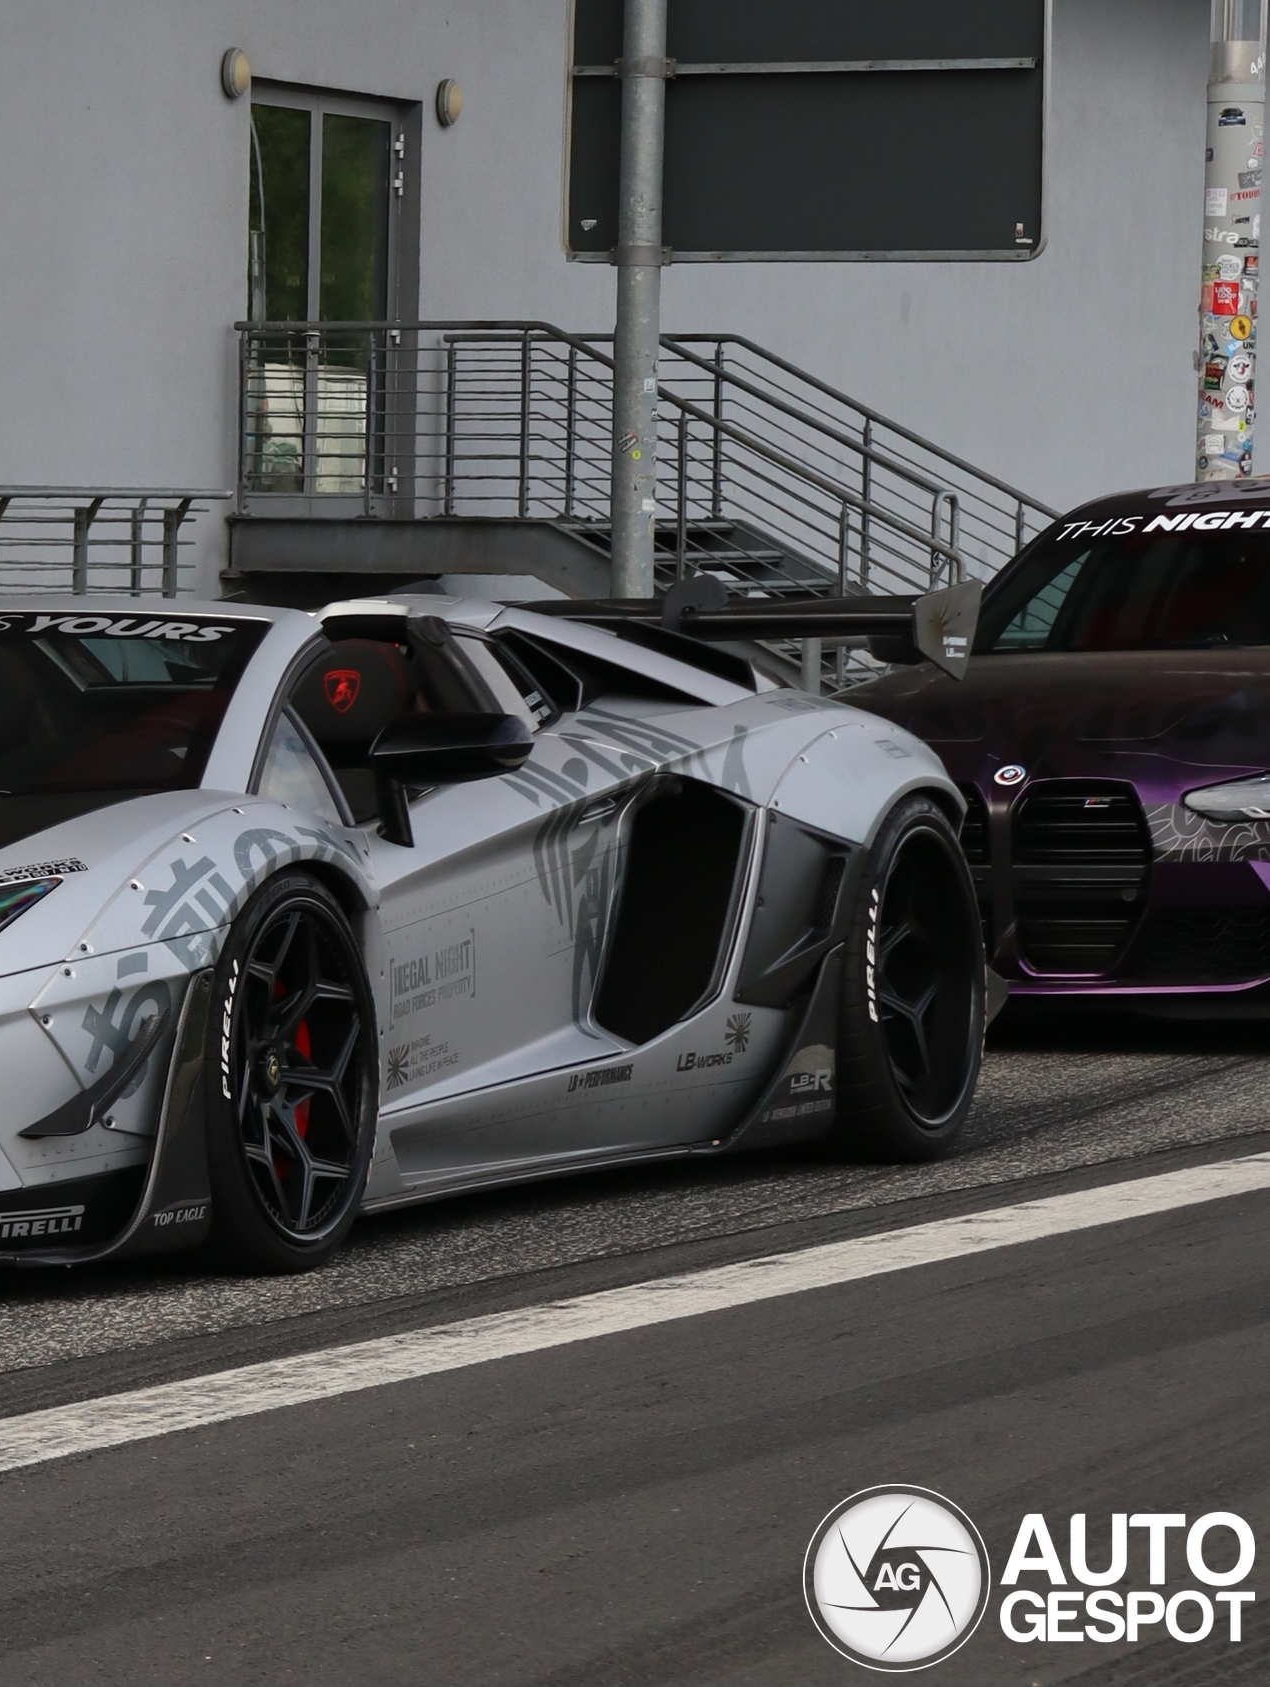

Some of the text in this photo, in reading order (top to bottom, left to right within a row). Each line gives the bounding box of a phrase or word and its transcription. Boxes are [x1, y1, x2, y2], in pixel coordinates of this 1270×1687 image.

[1055, 516, 1143, 541] THIS
[26, 616, 236, 642] YOURS
[394, 940, 471, 996] ILLEGAL NIGHT
[866, 888, 879, 1023] PIRELLI
[221, 959, 239, 1100] PIRELLI
[790, 1068, 832, 1091] LB-R
[153, 1206, 207, 1227] TOP EAGLE
